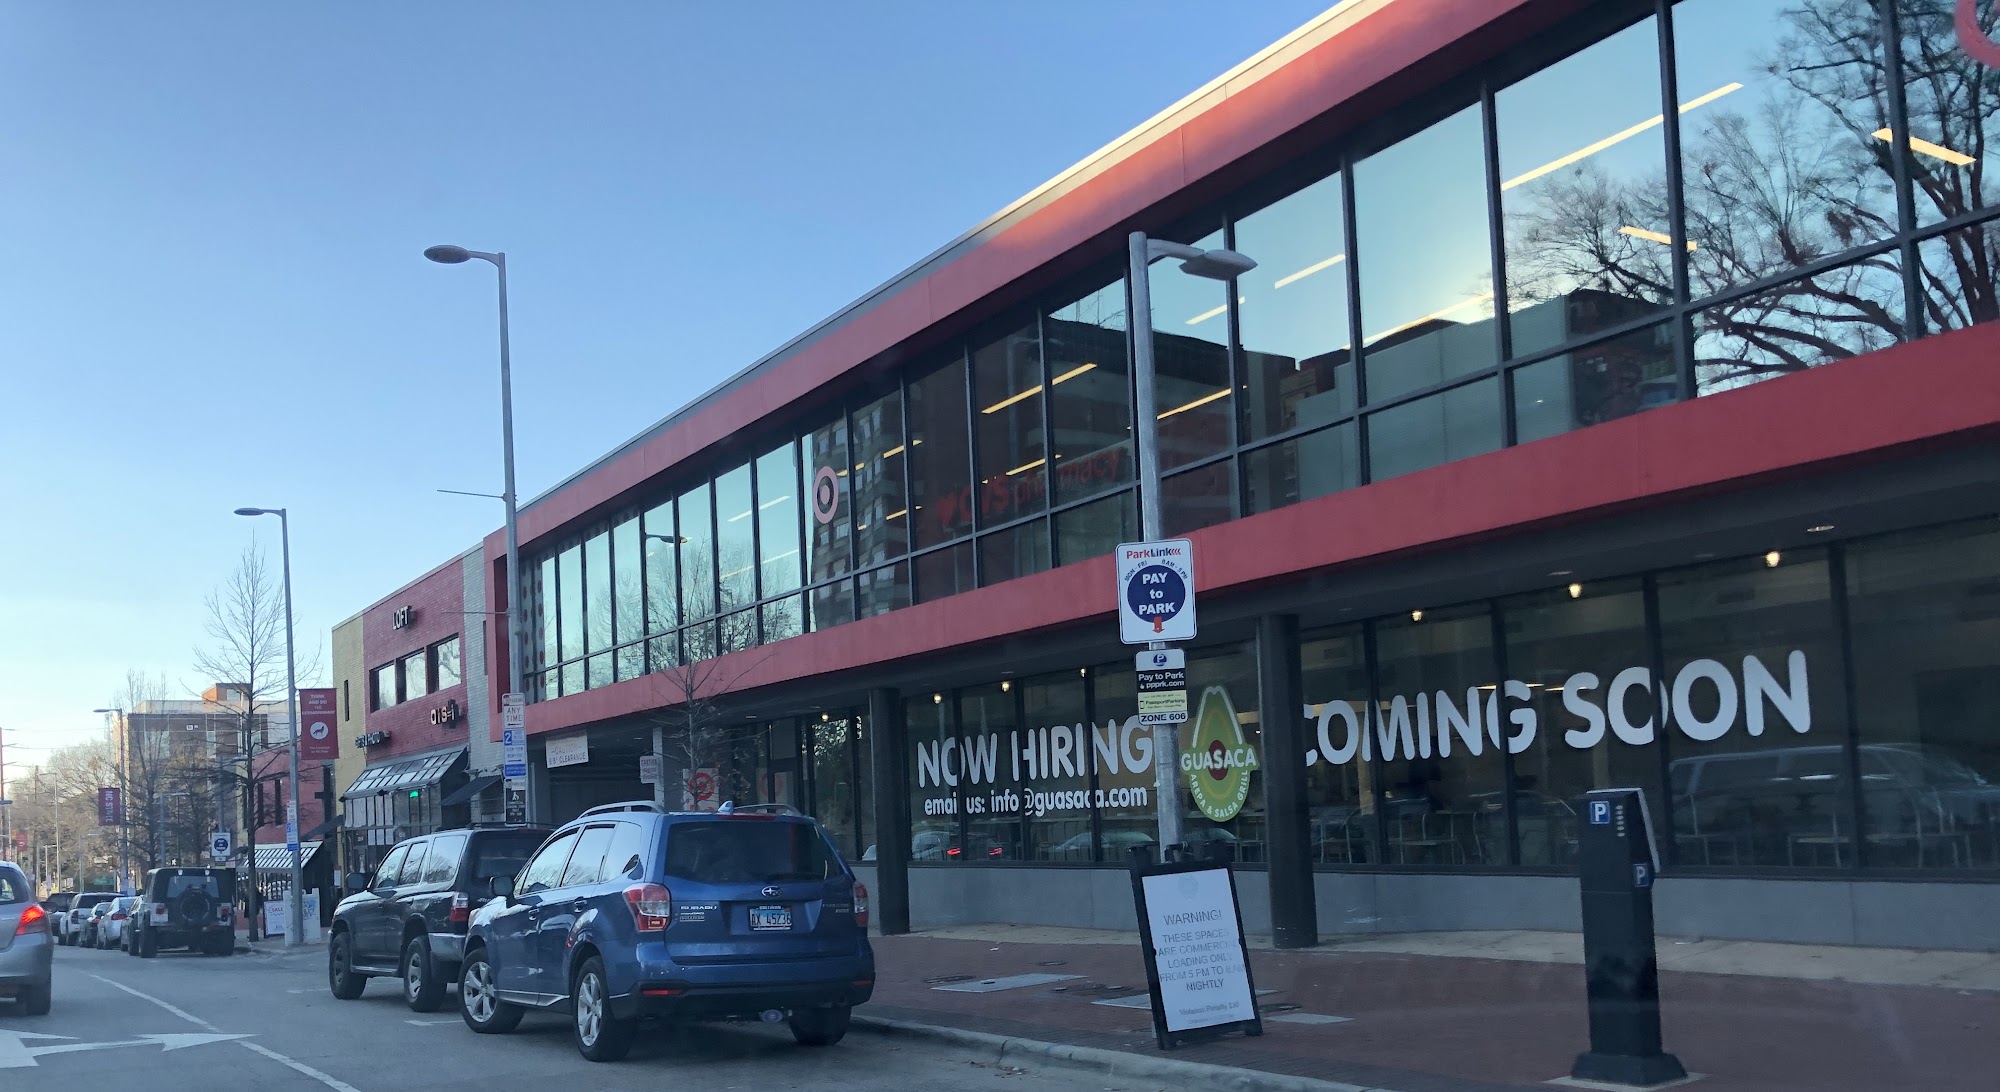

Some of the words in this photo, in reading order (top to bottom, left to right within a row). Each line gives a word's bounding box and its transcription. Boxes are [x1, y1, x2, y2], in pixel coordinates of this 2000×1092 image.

[1126, 547, 1172, 559] ParkLink
[1137, 560, 1148, 569] FRI
[1142, 572, 1168, 585] PAY
[1149, 588, 1164, 599] to
[1138, 602, 1176, 615] PARK
[392, 605, 410, 631] LOFT
[1138, 673, 1154, 682] Pay
[1164, 671, 1184, 680] Park
[1562, 649, 1812, 749] SOON
[1140, 714, 1167, 722] ZONE
[1169, 712, 1186, 721] 606
[504, 732, 512, 744] 2
[1010, 714, 1153, 782] HIRING
[917, 732, 998, 788] NOW
[1180, 747, 1257, 771] GUASACA
[1190, 774, 1206, 808] AREPA
[1206, 805, 1213, 815] &
[1214, 801, 1239, 818] SALSA
[1237, 770, 1248, 801] GRILL
[924, 791, 958, 816] emai
[966, 795, 986, 814] us:
[1163, 909, 1222, 926] WARNING!
[1162, 931, 1193, 944] THESE
[1167, 955, 1208, 969] LOADING
[1160, 971, 1187, 983] FROM
[1188, 970, 1194, 979] 5
[1196, 967, 1210, 978] PM
[1211, 965, 1224, 976] TO
[1186, 978, 1224, 992] NIGHTLY
